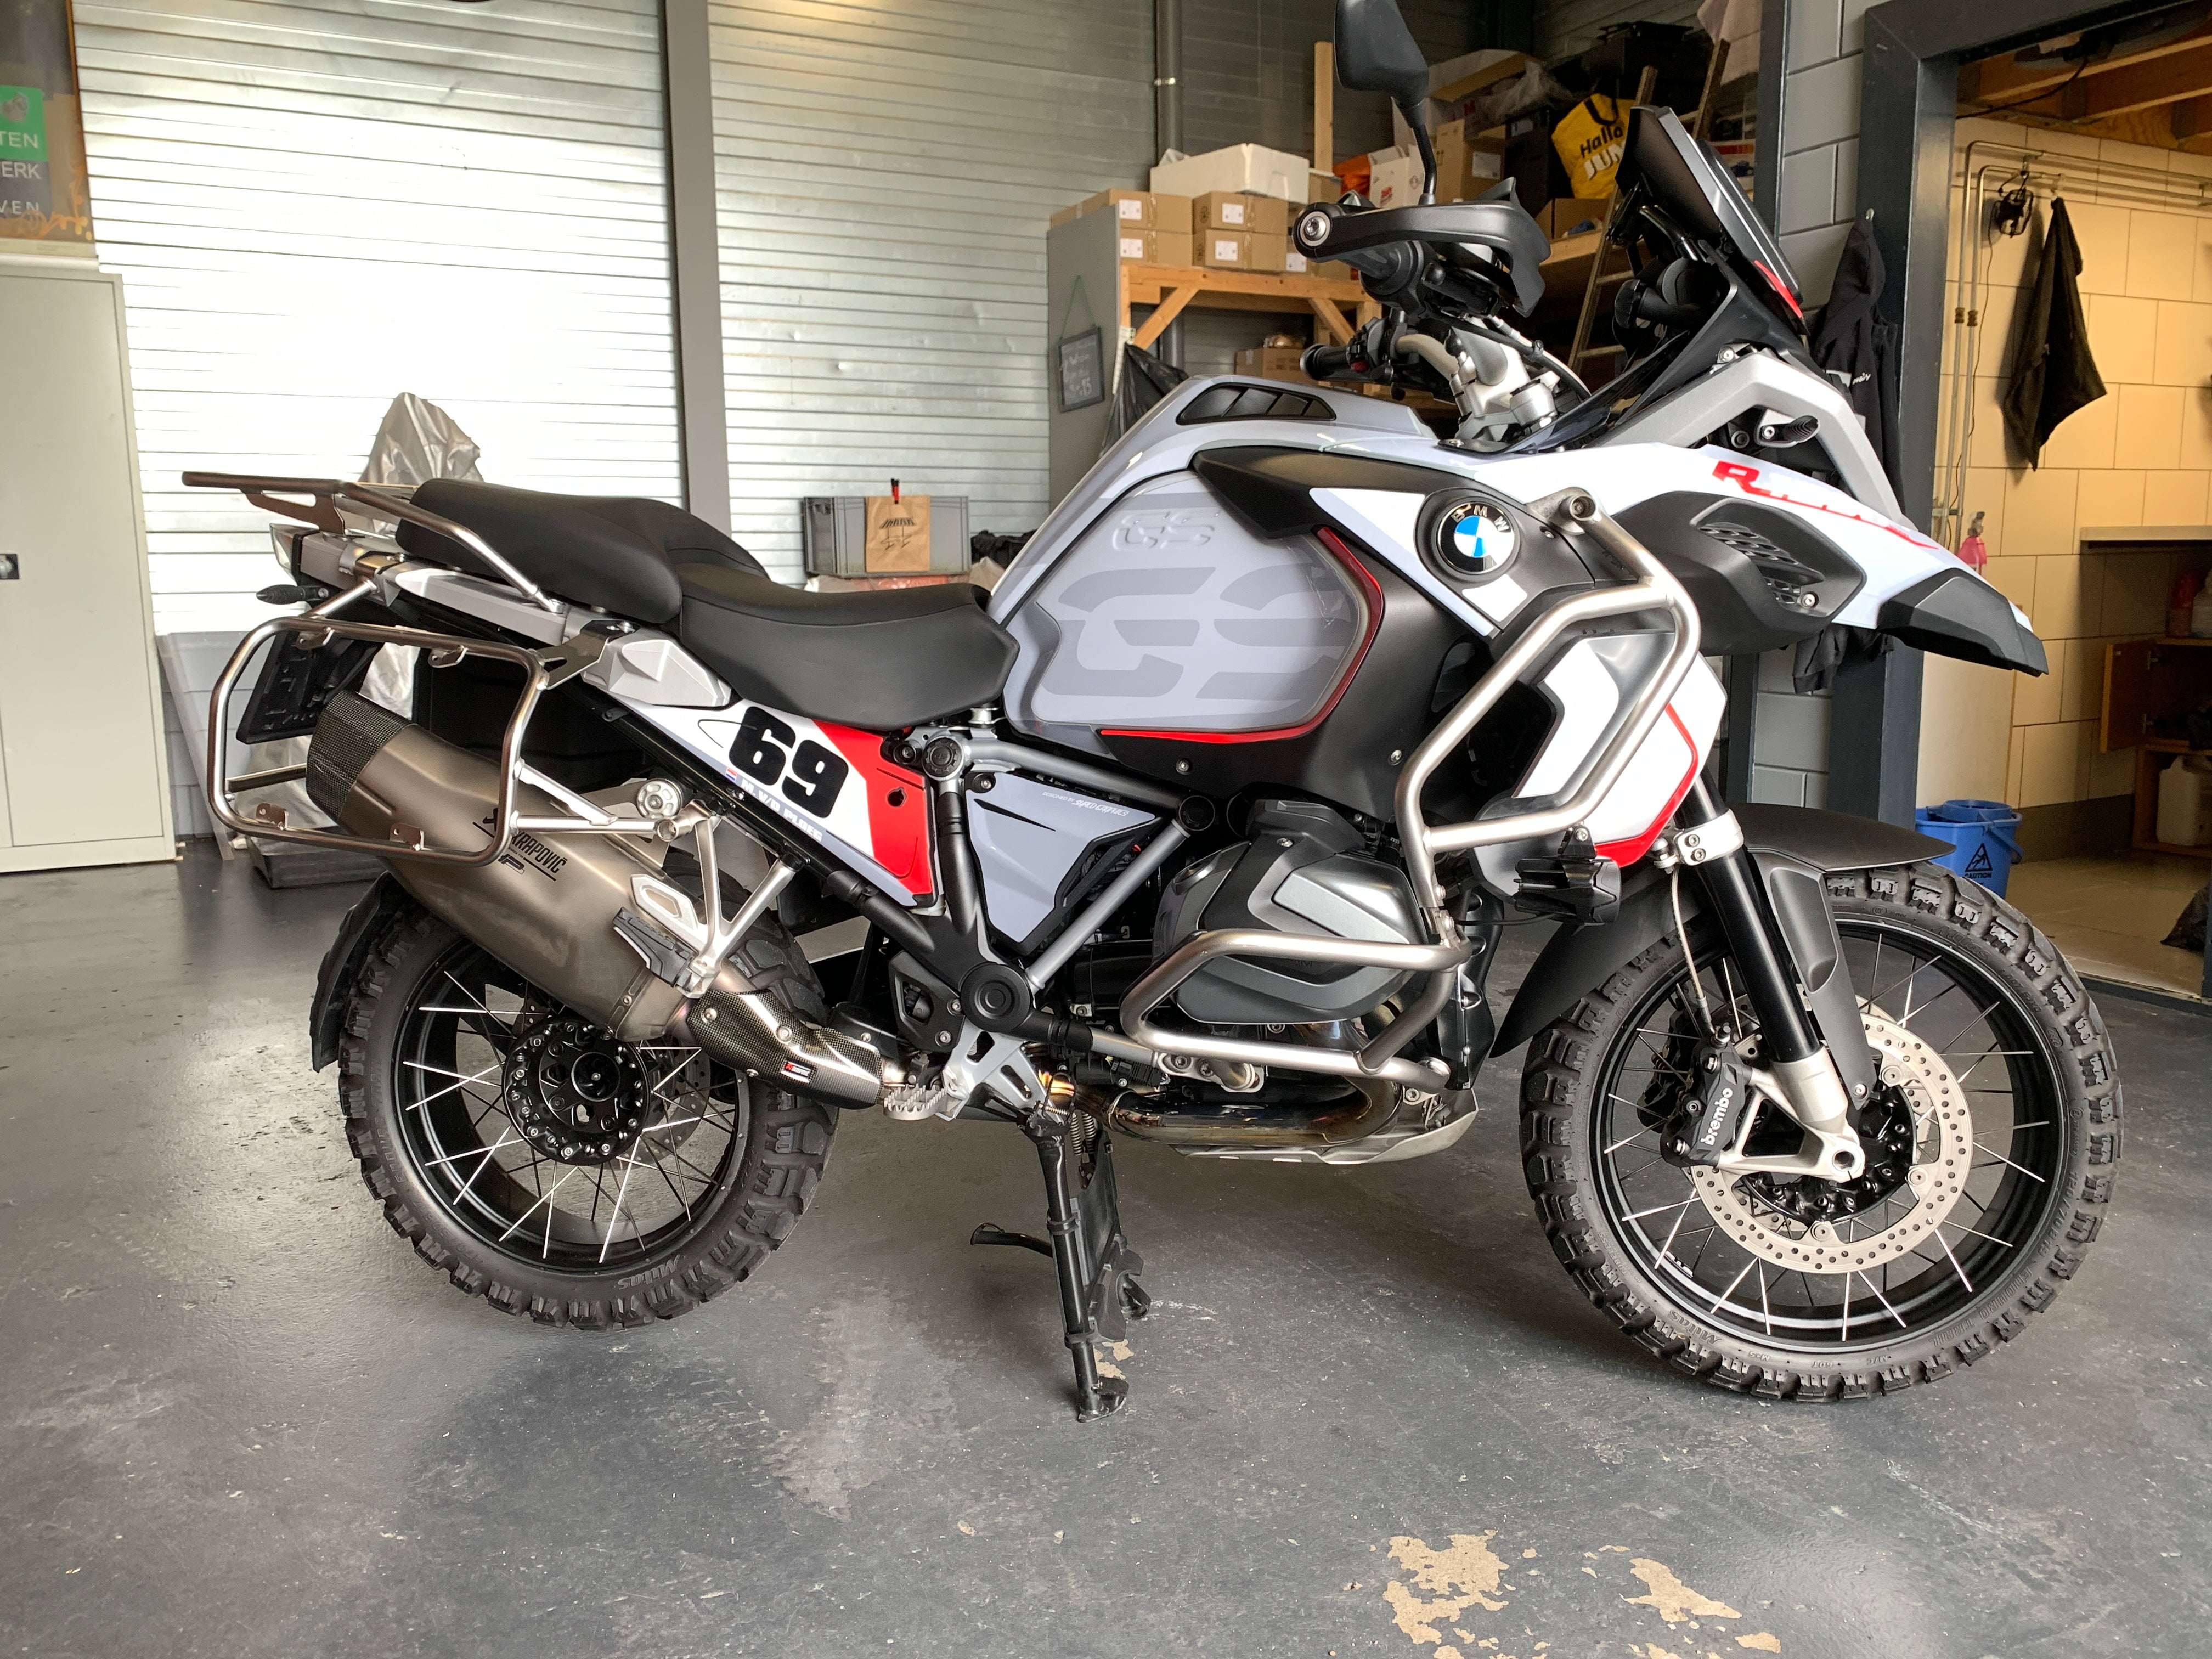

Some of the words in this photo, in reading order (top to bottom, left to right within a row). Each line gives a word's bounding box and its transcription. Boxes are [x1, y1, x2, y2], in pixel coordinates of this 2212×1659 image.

[1580, 126, 1623, 158] Hallo
[0, 161, 41, 179] ERK
[1112, 511, 1219, 551] GS
[1451, 505, 1511, 533] BMW
[1040, 565, 1352, 699] GS
[729, 706, 849, 819] 69
[741, 778, 755, 796] M.
[759, 790, 781, 812] V/D
[783, 808, 823, 842] PLOEG
[1042, 792, 1068, 801] DESIGNED
[511, 831, 568, 874] KRAPOVIČ
[1700, 1088, 1733, 1146] brembo
[617, 1254, 685, 1290] Mitas
[1597, 1230, 1628, 1275] TUBELESS
[1977, 1266, 2034, 1321] ENDURO
[1664, 1308, 1722, 1348] Mitas
[1928, 1317, 1976, 1348] TRAIL
[1747, 1350, 1771, 1362] M+S
[1866, 1355, 1888, 1365] M/C
